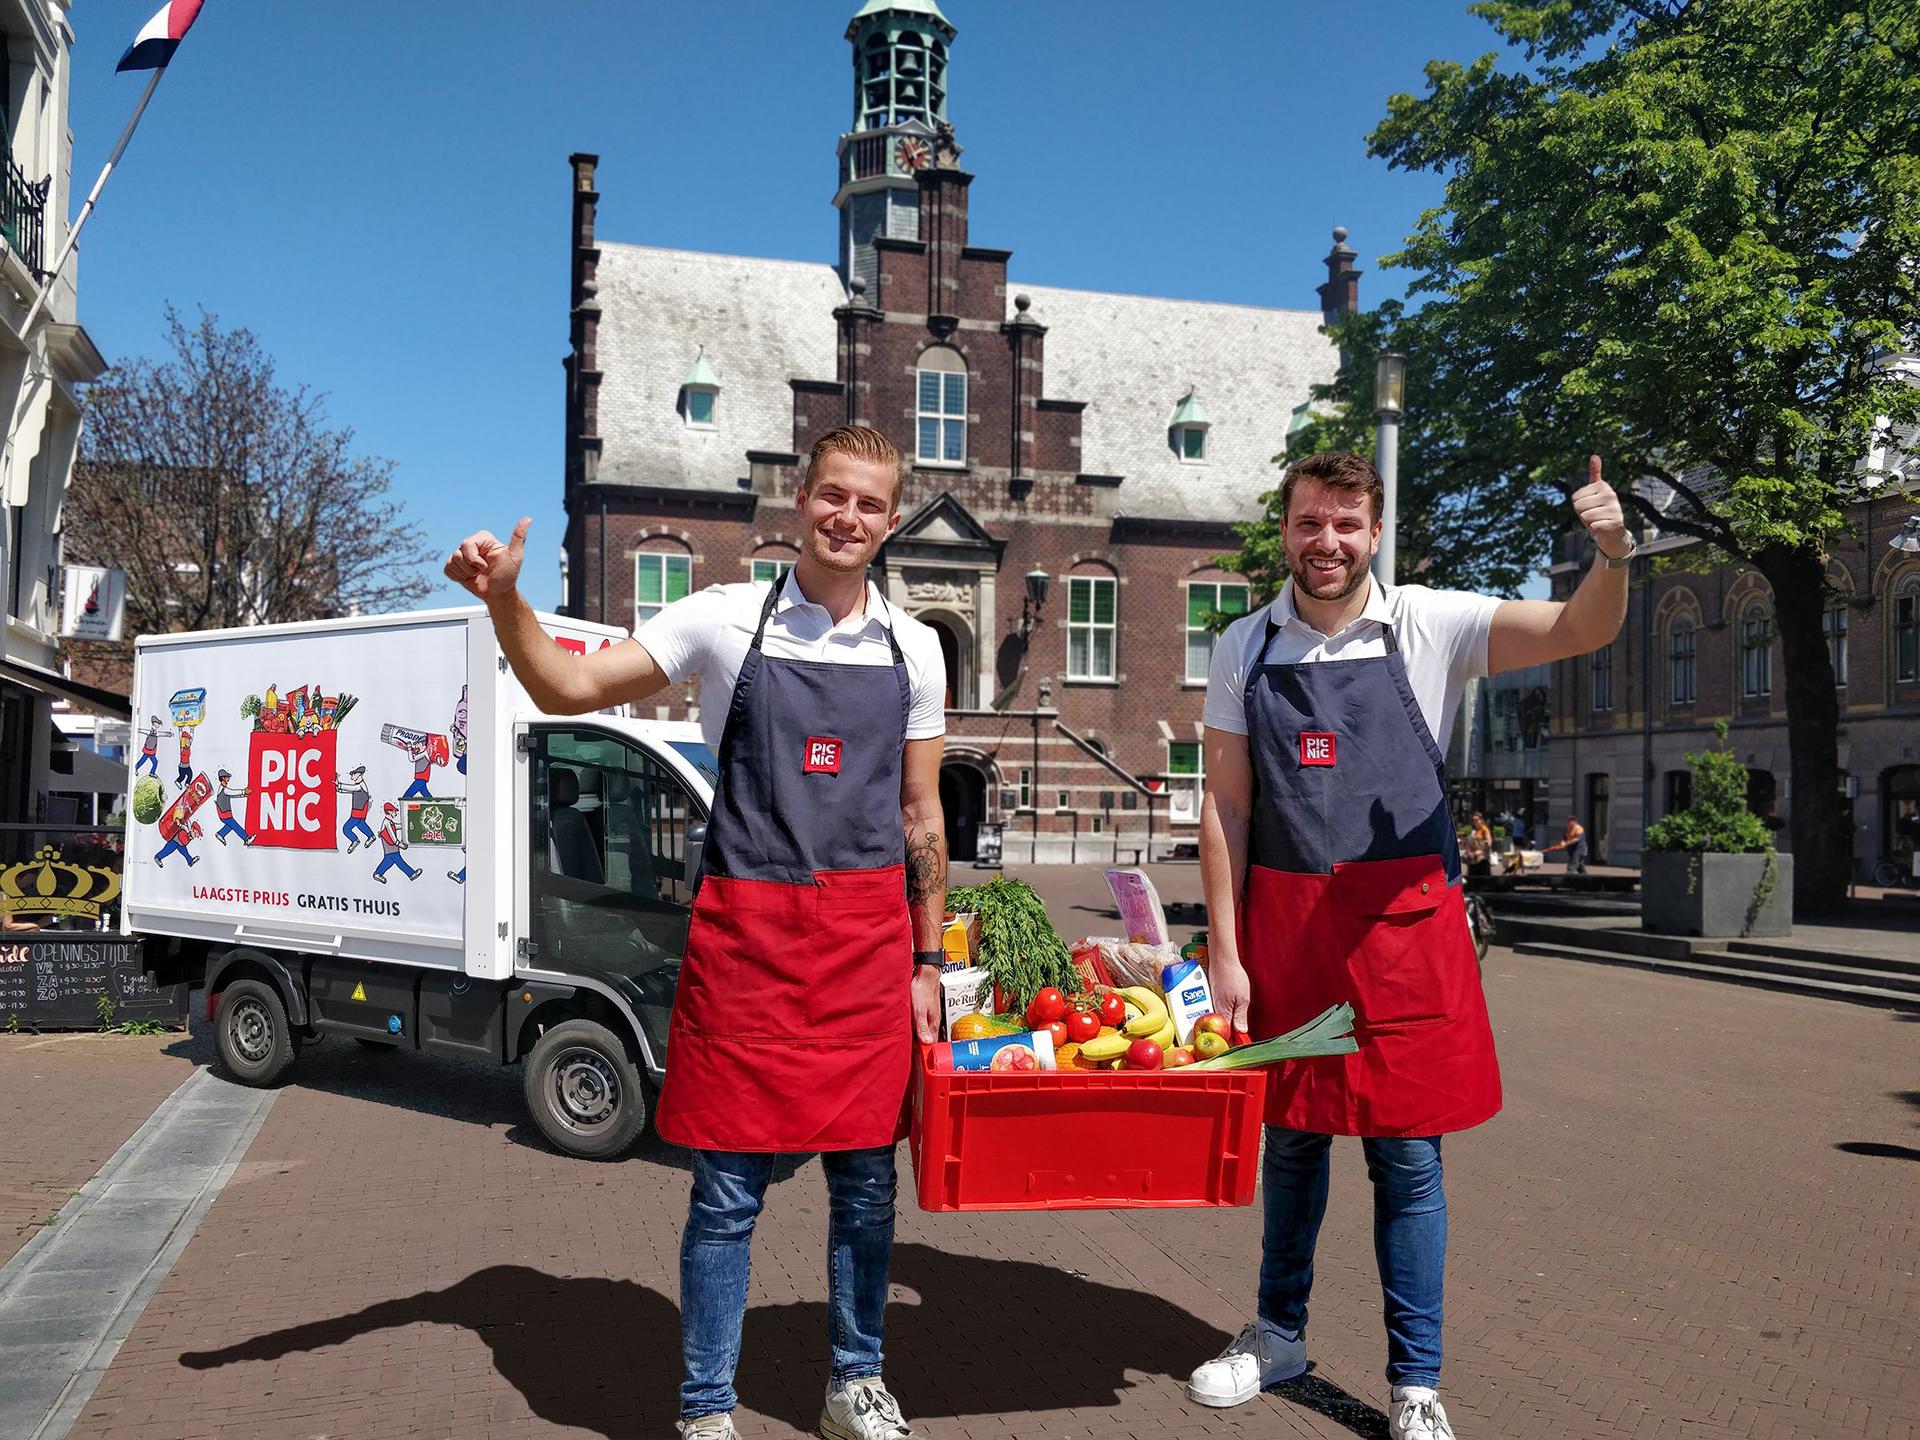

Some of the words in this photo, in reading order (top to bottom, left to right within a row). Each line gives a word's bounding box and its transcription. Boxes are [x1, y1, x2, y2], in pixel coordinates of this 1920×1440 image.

[396, 728, 420, 742] PRODEN
[193, 886, 249, 902] LAAGSTE
[253, 890, 289, 906] PRIJS
[297, 894, 349, 911] GRATIS
[353, 898, 400, 916] THUIS
[947, 997, 960, 1008] De
[961, 991, 980, 1005] Rui
[1183, 989, 1204, 1001] Sanex
